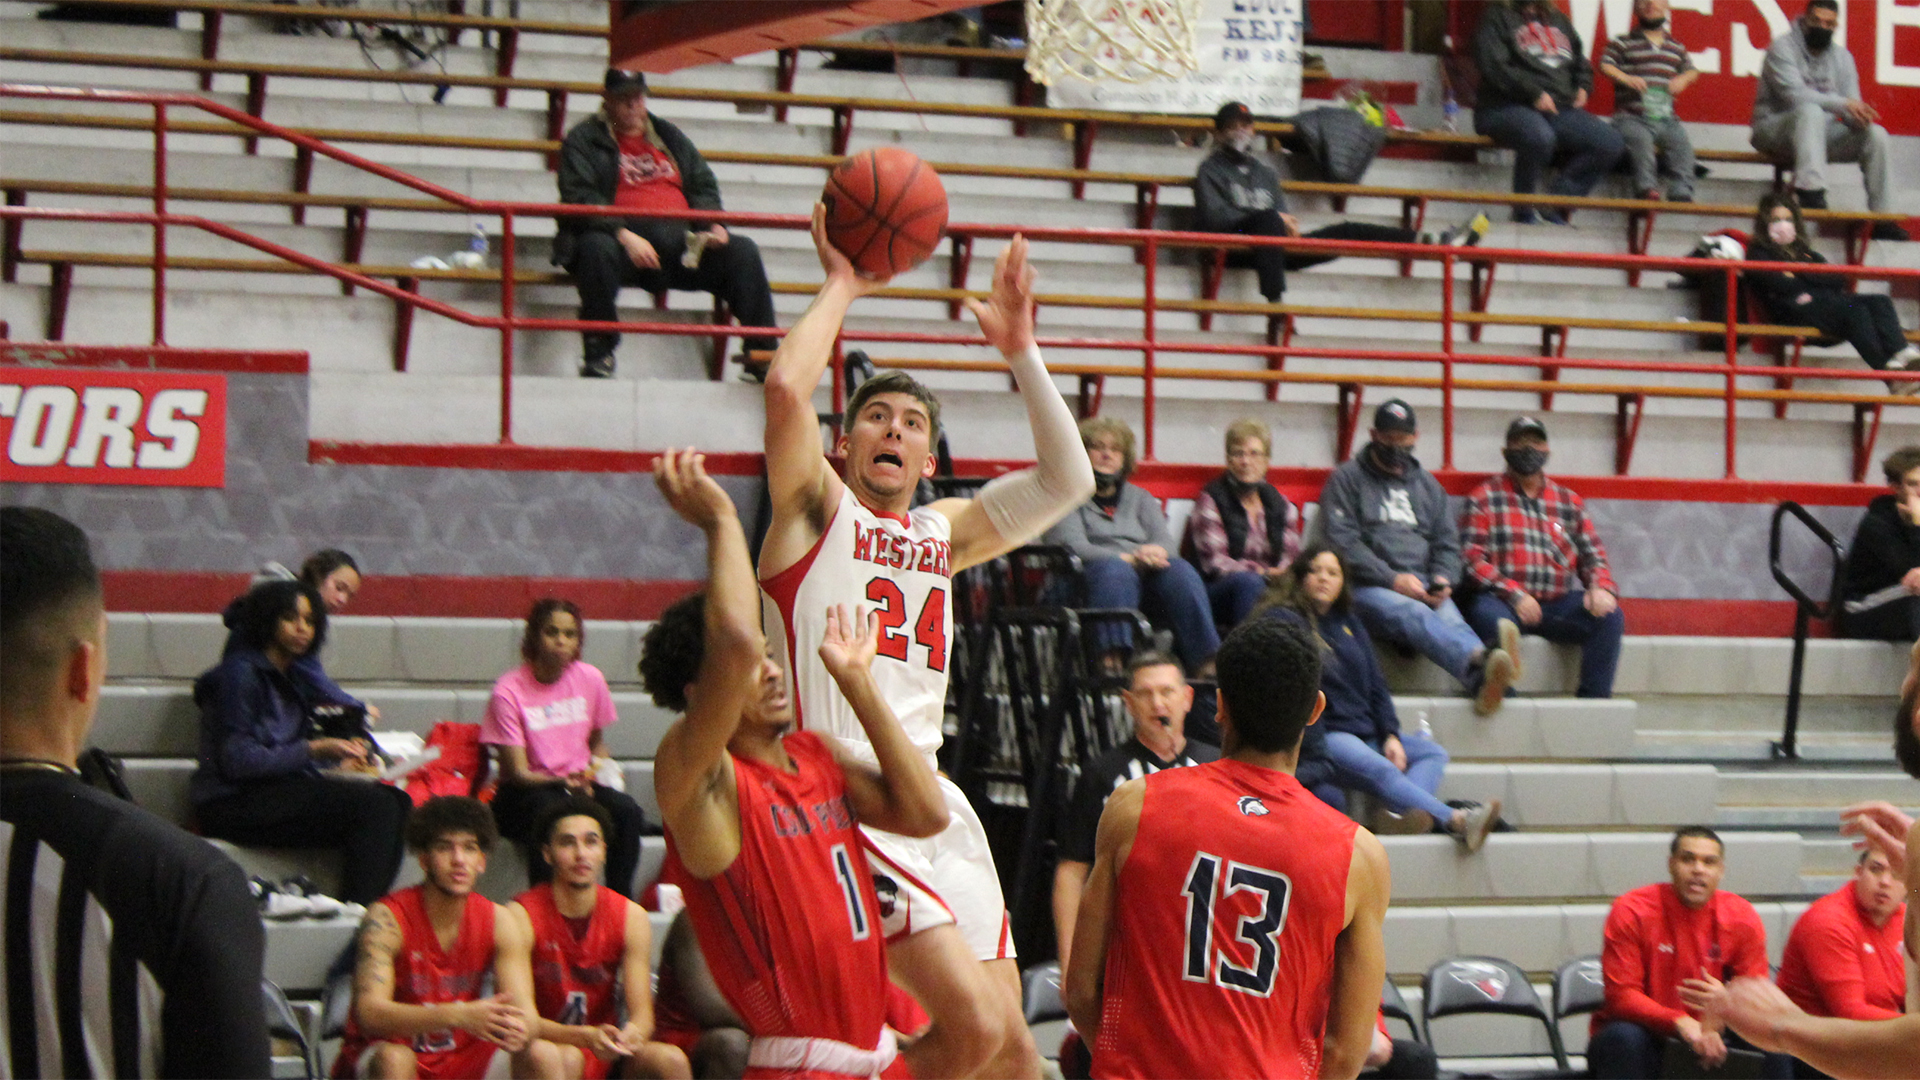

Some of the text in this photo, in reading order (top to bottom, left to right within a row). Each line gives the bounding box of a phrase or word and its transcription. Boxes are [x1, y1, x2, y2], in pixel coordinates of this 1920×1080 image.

[1222, 47, 1250, 63] FM
[866, 576, 947, 674] 24
[831, 842, 871, 942] 1
[1180, 850, 1293, 998] 13
